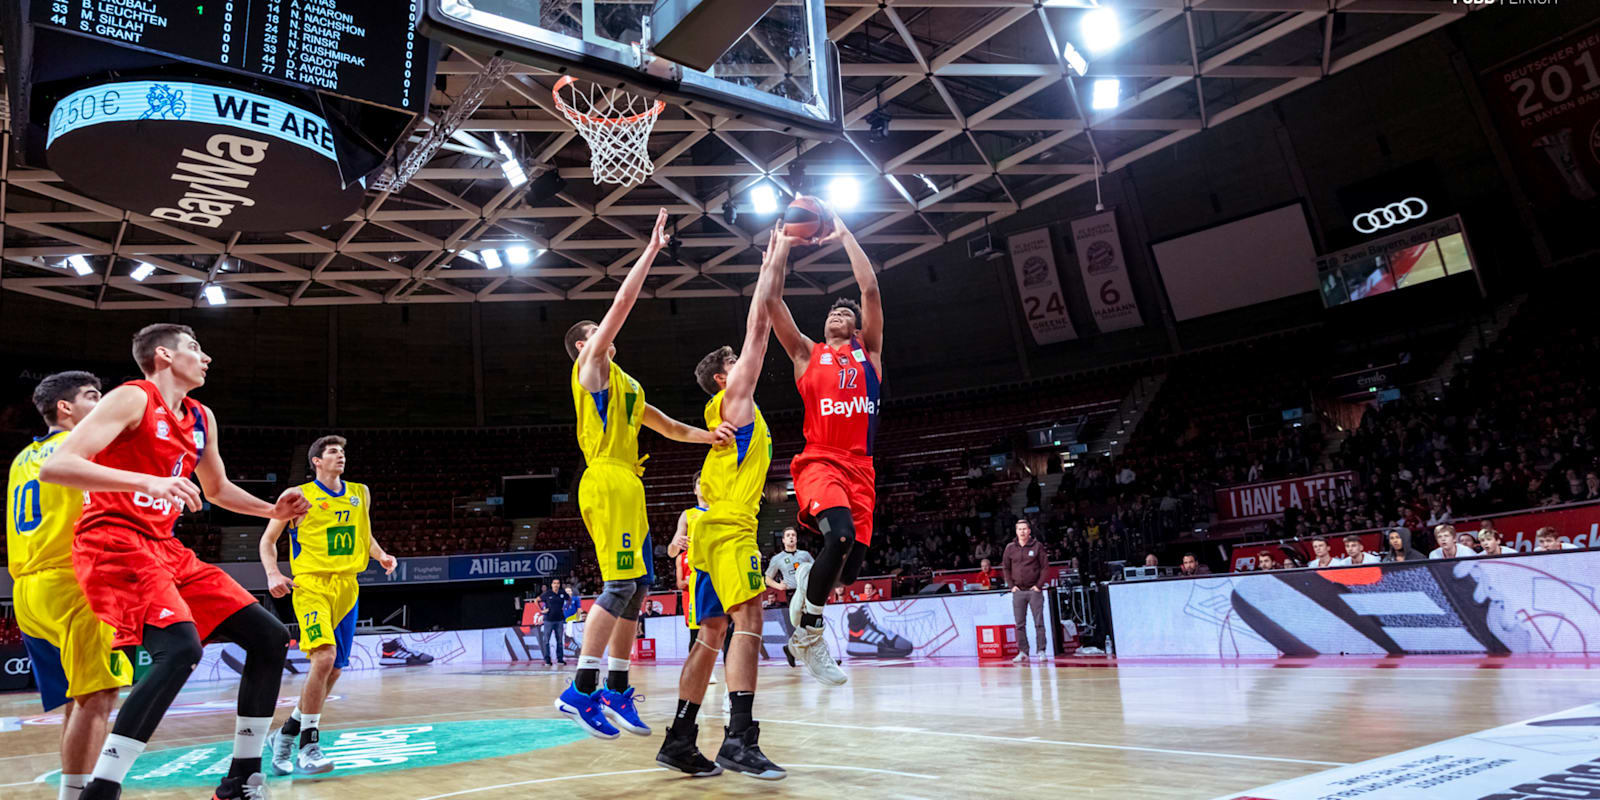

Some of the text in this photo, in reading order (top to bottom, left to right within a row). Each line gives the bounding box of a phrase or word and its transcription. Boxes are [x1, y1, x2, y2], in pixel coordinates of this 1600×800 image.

[52, 0, 167, 27] 33 B. LEUCHTEN
[196, 5, 204, 15] 1
[224, 12, 232, 22] 0
[226, 2, 233, 12] 0
[268, 3, 280, 14] 14
[304, 3, 353, 24] AHARONI
[50, 9, 144, 32] 44 M. SILLAH
[224, 22, 231, 32] 0
[264, 20, 340, 40] 24 N. SAHAR
[266, 9, 365, 37] 18 N. NACHSHON
[80, 20, 142, 43] S. GRANT
[222, 33, 230, 42] 0
[264, 30, 338, 50] 25 H. RINSKI
[222, 43, 230, 53] 0
[263, 40, 366, 67] 33 N. KUSHMIRAK
[220, 54, 229, 64] 0
[261, 59, 338, 80] 77 D. AVDIJA
[262, 49, 339, 70] 44 Y. GADOT
[1504, 46, 1575, 83] DEUTSCHER
[285, 69, 337, 90] R. HAYUN
[1509, 50, 1600, 117] 201
[213, 94, 335, 152] WE ARE
[150, 134, 270, 228] BayWa
[1100, 280, 1120, 305] 6
[1024, 292, 1064, 321] 24
[1094, 303, 1136, 315] HAMANN
[838, 368, 858, 389] 12
[820, 396, 875, 418] BayWa
[14, 479, 42, 534] 10
[1230, 491, 1238, 518] I
[1240, 484, 1286, 516] HAVE
[1290, 483, 1303, 510] A
[335, 510, 350, 522] 77
[622, 533, 631, 548] 6
[469, 558, 532, 575] Allianz
[750, 556, 758, 570] 8
[304, 611, 318, 626] 77
